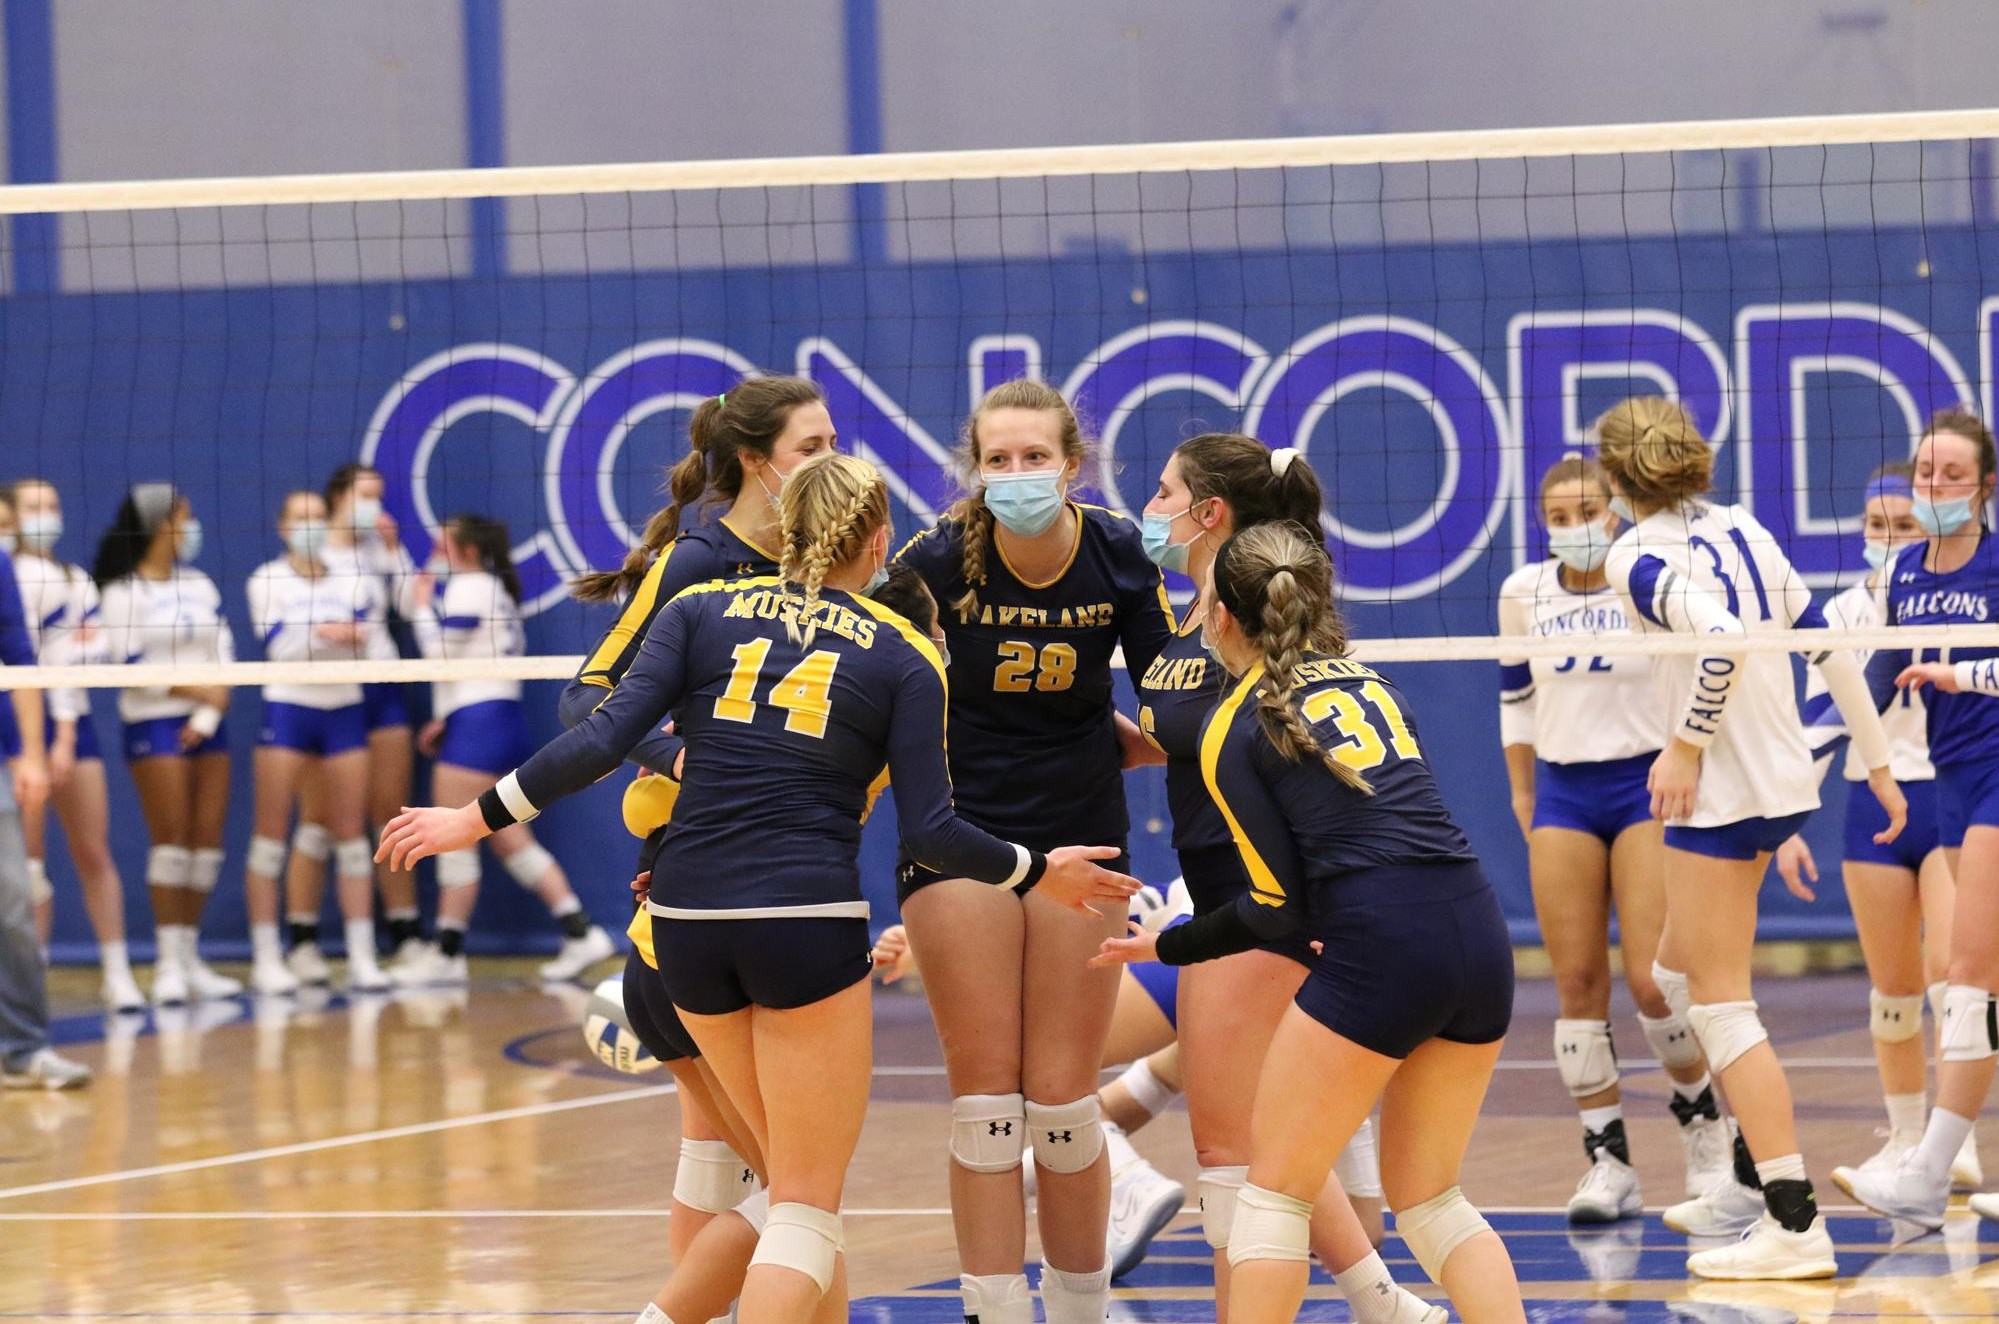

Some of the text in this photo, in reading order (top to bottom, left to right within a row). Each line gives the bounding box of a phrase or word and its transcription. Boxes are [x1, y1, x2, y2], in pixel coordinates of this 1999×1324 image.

[361, 295, 1999, 619] CONCORD
[1689, 527, 1772, 621] 31
[712, 637, 841, 739] 14
[993, 641, 1077, 692] 28
[1686, 625, 1735, 736] FALCO
[1301, 680, 1421, 771] 31
